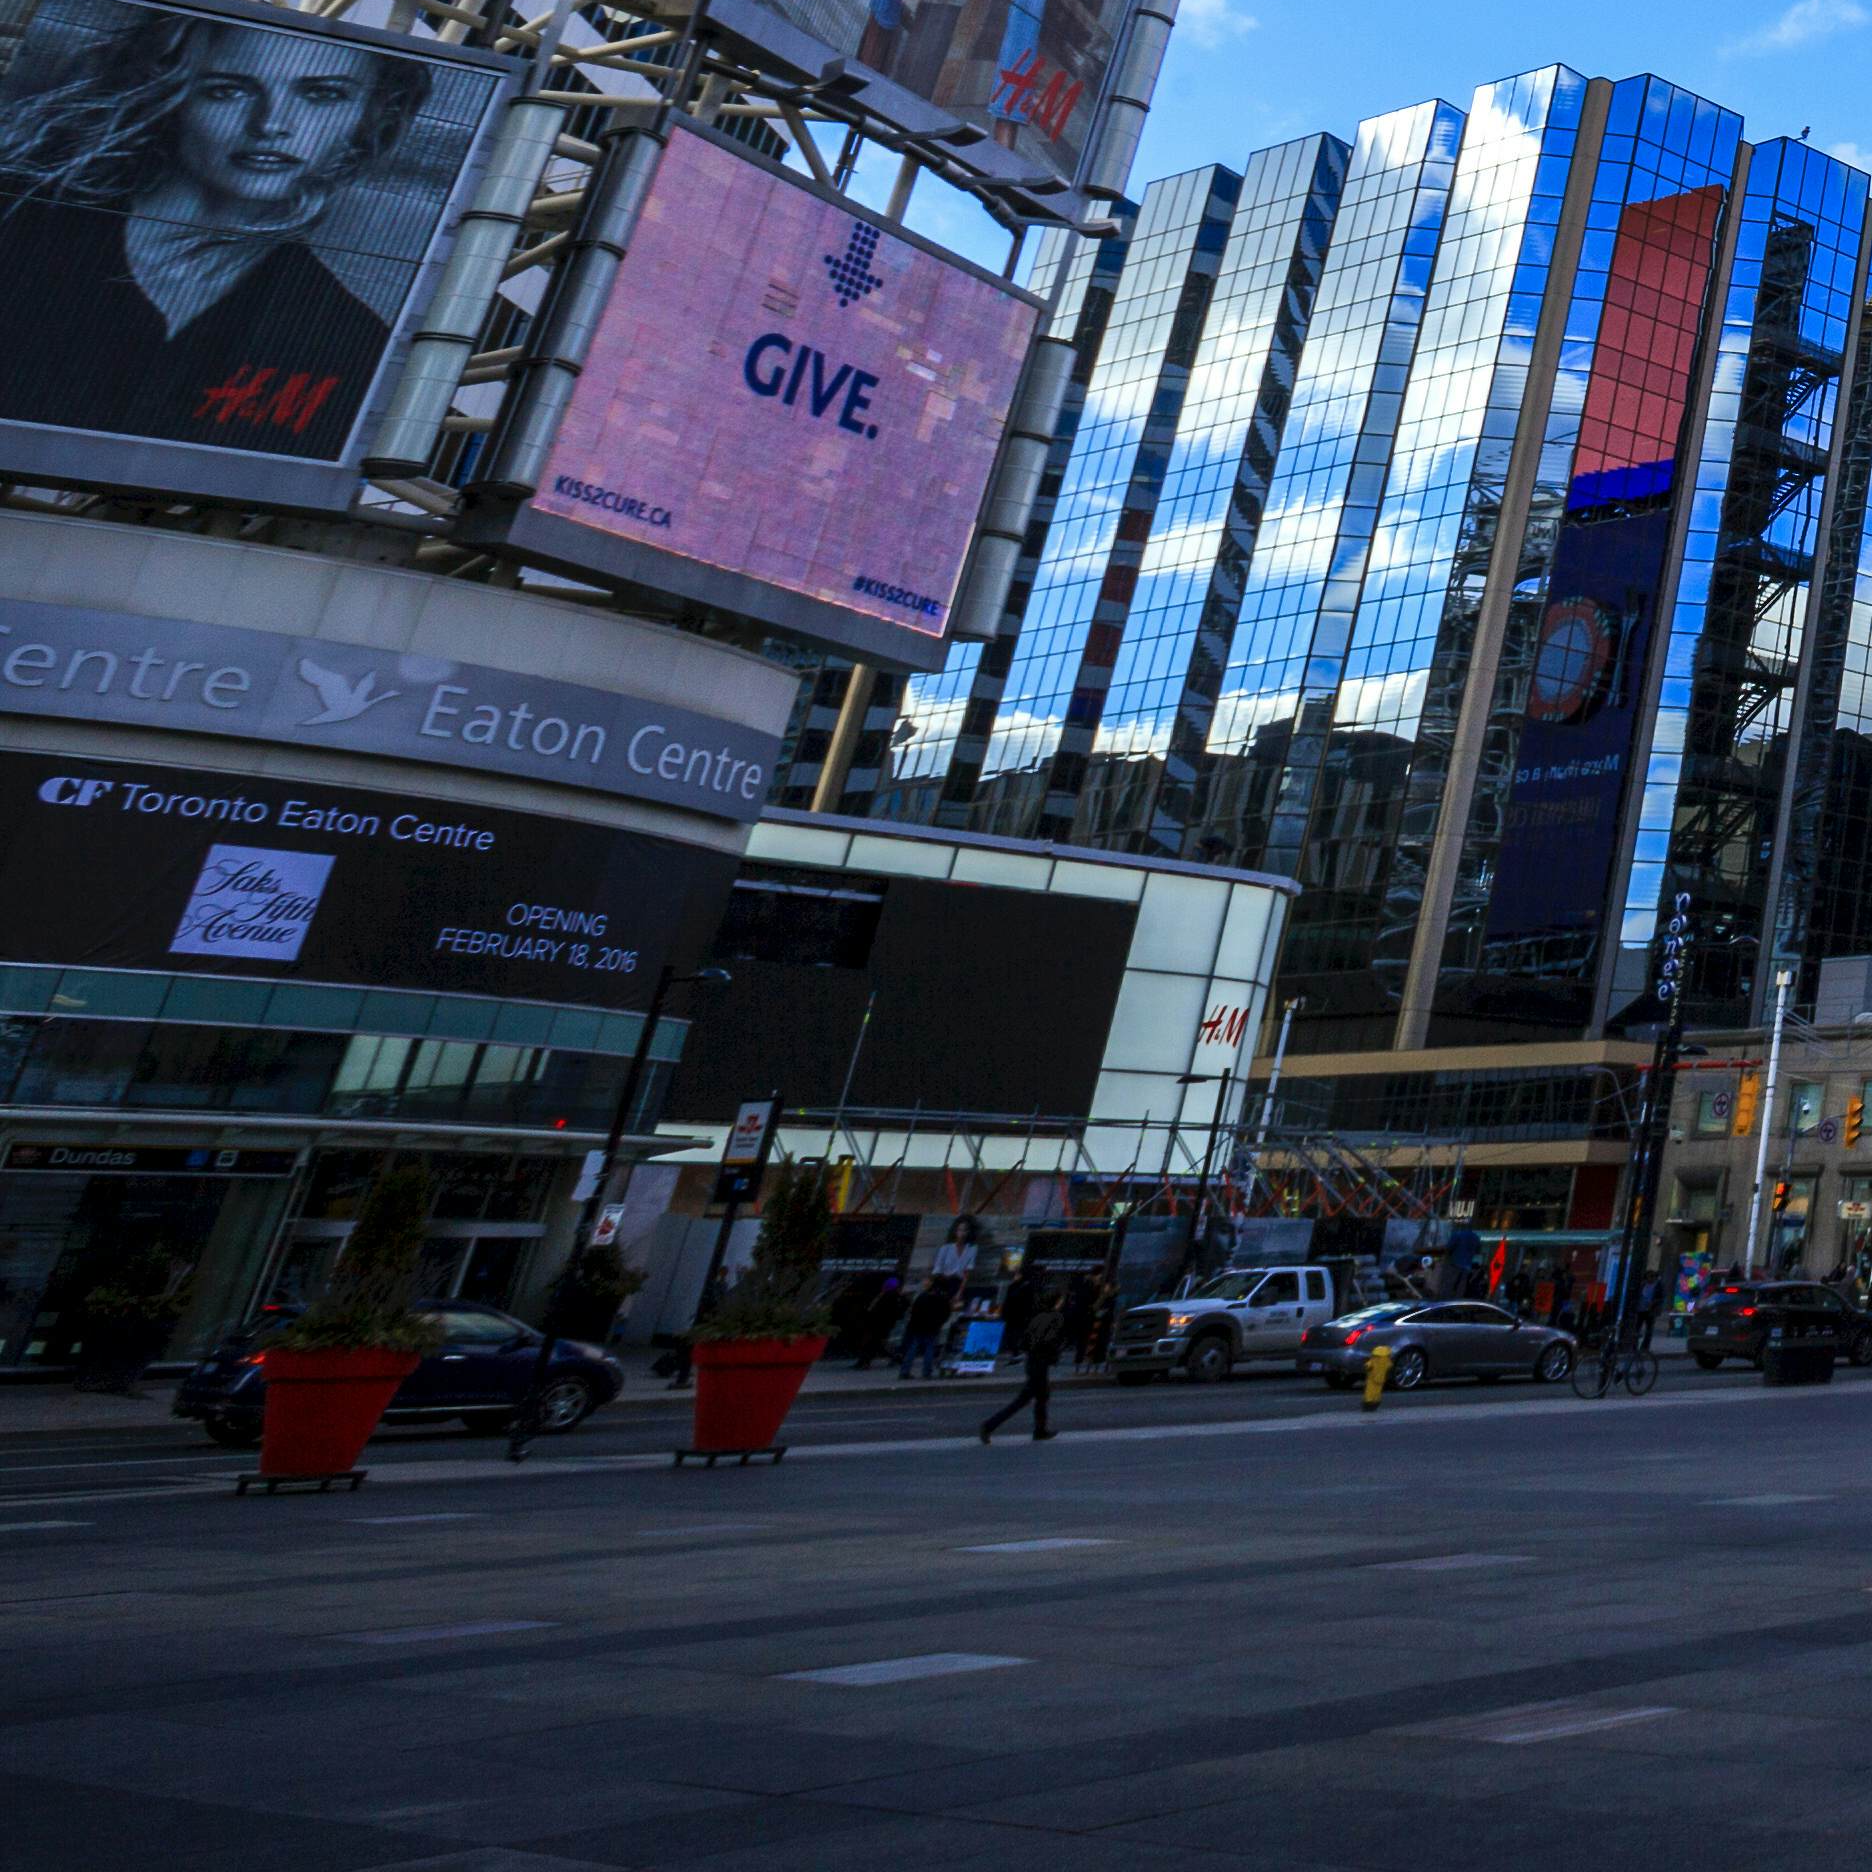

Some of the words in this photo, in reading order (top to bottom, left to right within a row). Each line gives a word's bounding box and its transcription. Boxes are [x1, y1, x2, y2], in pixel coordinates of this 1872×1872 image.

[999, 48, 1083, 143] H&M
[194, 364, 340, 434] H&M
[743, 332, 881, 440] GIVE.
[553, 475, 674, 528] KISS2CURE.CA
[852, 575, 941, 617] #KISS2CURE
[0, 628, 253, 709] entre
[420, 684, 607, 764] Eaton
[626, 724, 764, 801] Centre
[39, 776, 114, 807] CF
[120, 781, 268, 824] Toronto
[277, 799, 380, 837] Eaton
[389, 814, 496, 851] Centre
[193, 859, 282, 897] Saks
[175, 903, 297, 946] Avenue
[506, 903, 608, 937] OPENING
[435, 928, 565, 964] FEBRUARY
[567, 942, 591, 969] 18,
[594, 946, 638, 974] 2016
[1197, 1004, 1250, 1049] H&M
[49, 1146, 138, 1167] Dundas
